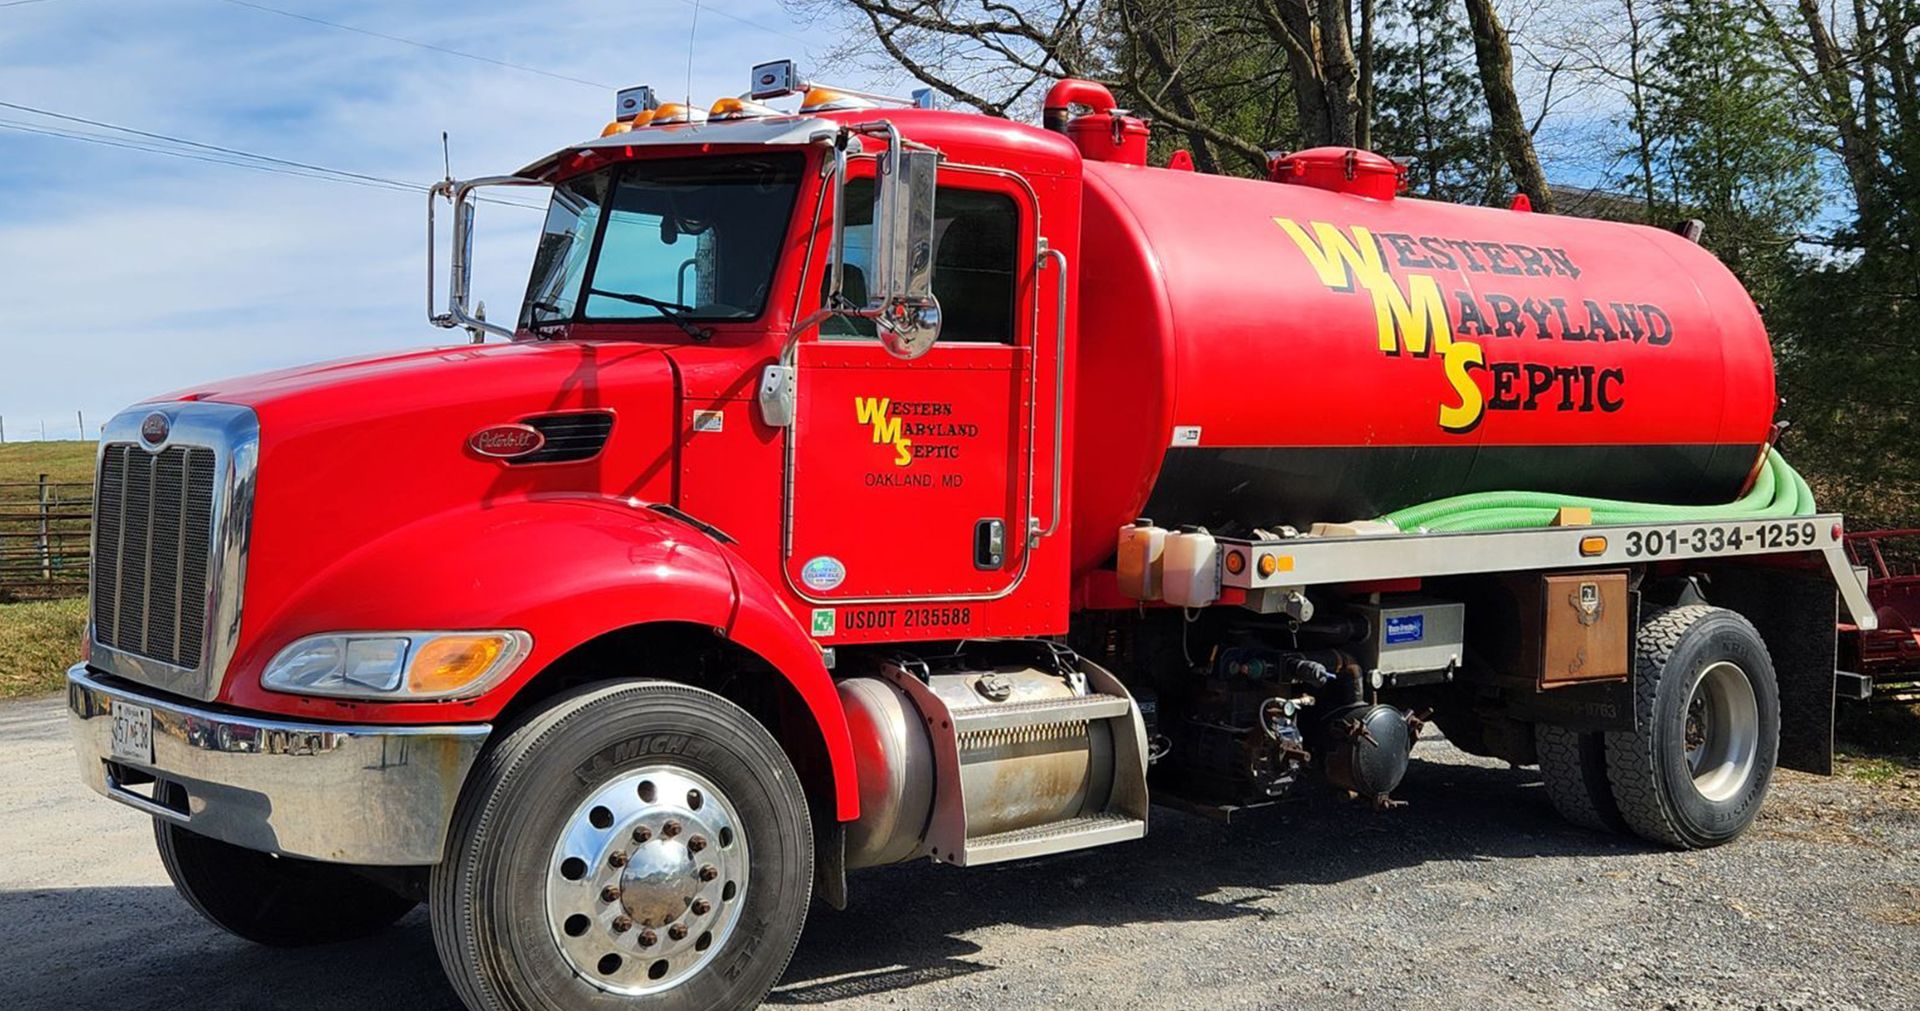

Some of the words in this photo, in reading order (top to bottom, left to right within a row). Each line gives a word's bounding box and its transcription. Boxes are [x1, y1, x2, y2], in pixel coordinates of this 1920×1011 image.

[1273, 217, 1581, 292] WESTERN
[1367, 273, 1673, 358] MARYLAND
[1439, 342, 1625, 434] SEPTIC
[855, 397, 952, 424] WESTERN
[479, 432, 531, 448] Peterbilt
[873, 418, 978, 444] MARYLAND
[895, 439, 959, 466] SEPTIC
[942, 474, 963, 487] MD
[1625, 522, 1816, 557] 301-334-1259
[845, 610, 897, 629] USDOT
[904, 608, 971, 627] 2135588
